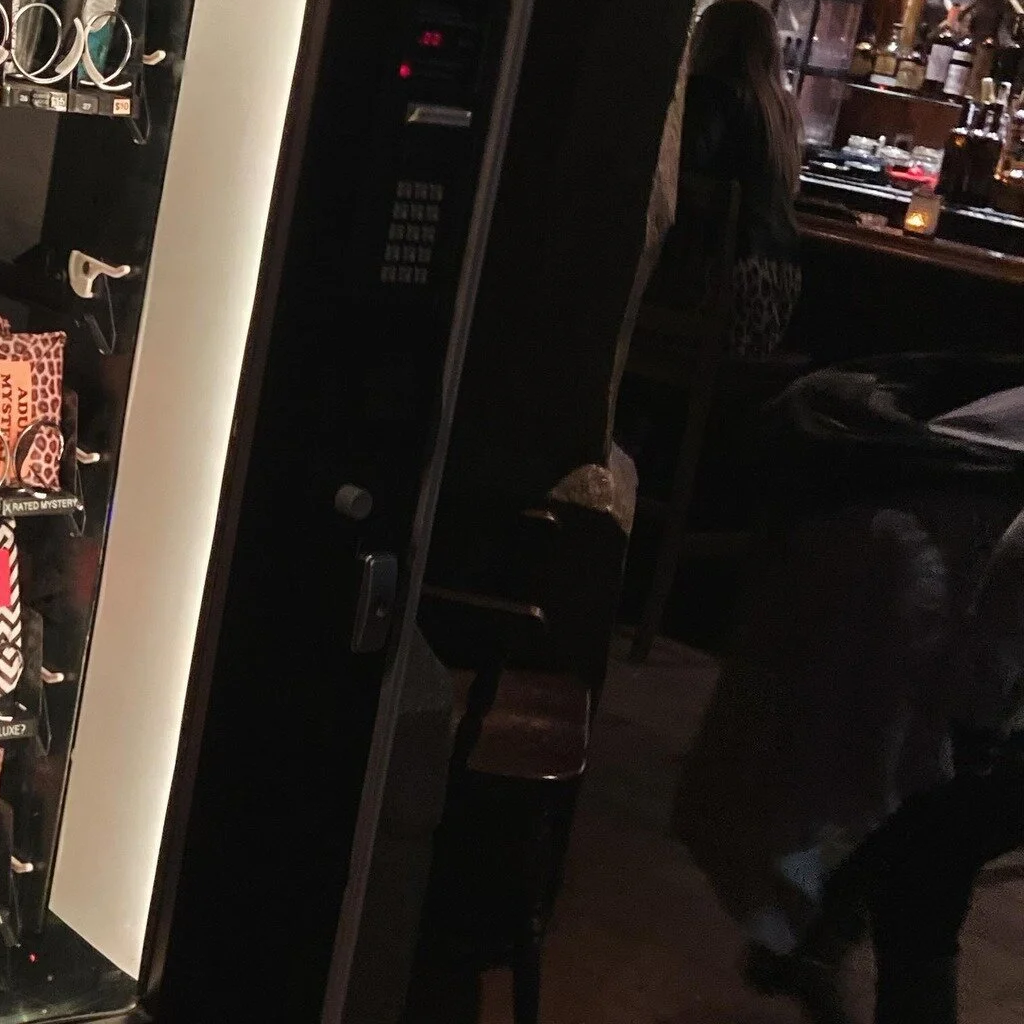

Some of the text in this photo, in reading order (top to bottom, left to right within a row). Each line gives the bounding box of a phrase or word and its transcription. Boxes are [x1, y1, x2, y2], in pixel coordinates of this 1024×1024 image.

[17, 386, 29, 436] ADU
[5, 497, 79, 514] X RATED MYSTERY
